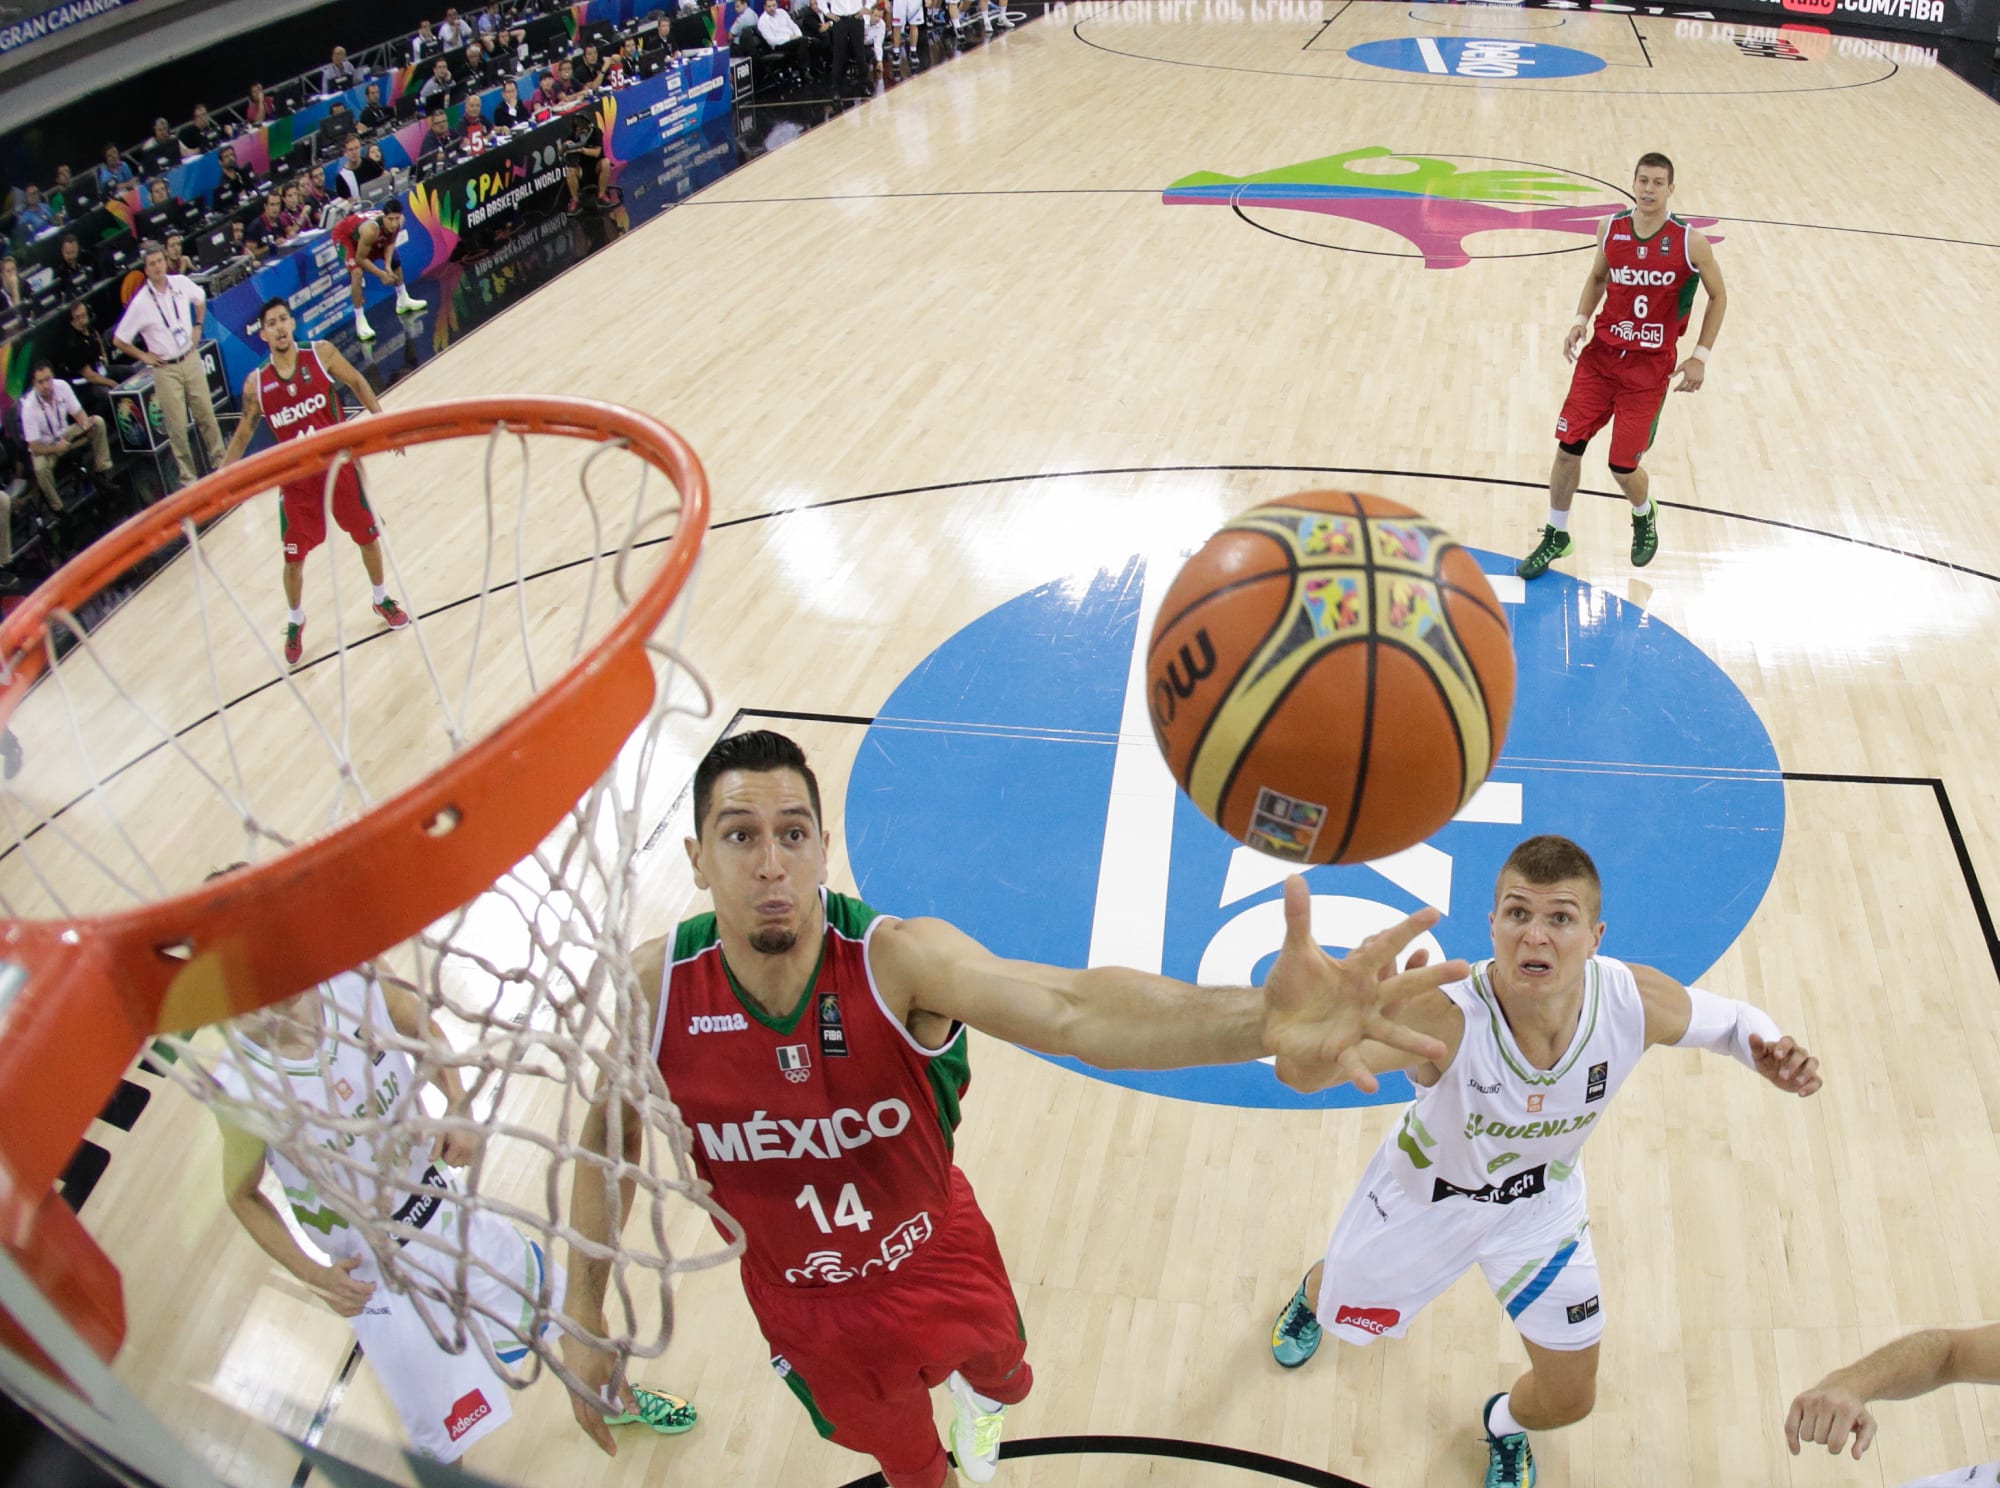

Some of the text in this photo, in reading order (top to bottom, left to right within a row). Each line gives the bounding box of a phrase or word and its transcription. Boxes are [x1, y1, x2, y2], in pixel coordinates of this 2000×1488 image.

[0, 16, 47, 49] GRAN
[1456, 41, 1536, 77] beko
[611, 68, 624, 87] 55
[471, 131, 483, 152] 5
[532, 138, 563, 174] 201
[467, 206, 486, 229] FIBA
[487, 182, 533, 222] BASKETBALL
[534, 171, 561, 192] WORLD
[1609, 265, 1676, 286] MÉXICO
[1633, 295, 1648, 318] 6
[270, 393, 326, 429] MÉXICO
[824, 1029, 843, 1041] FIBA
[697, 1098, 911, 1161] MÉXICO
[795, 1183, 873, 1234] 14
[451, 1403, 488, 1438] Adecco
